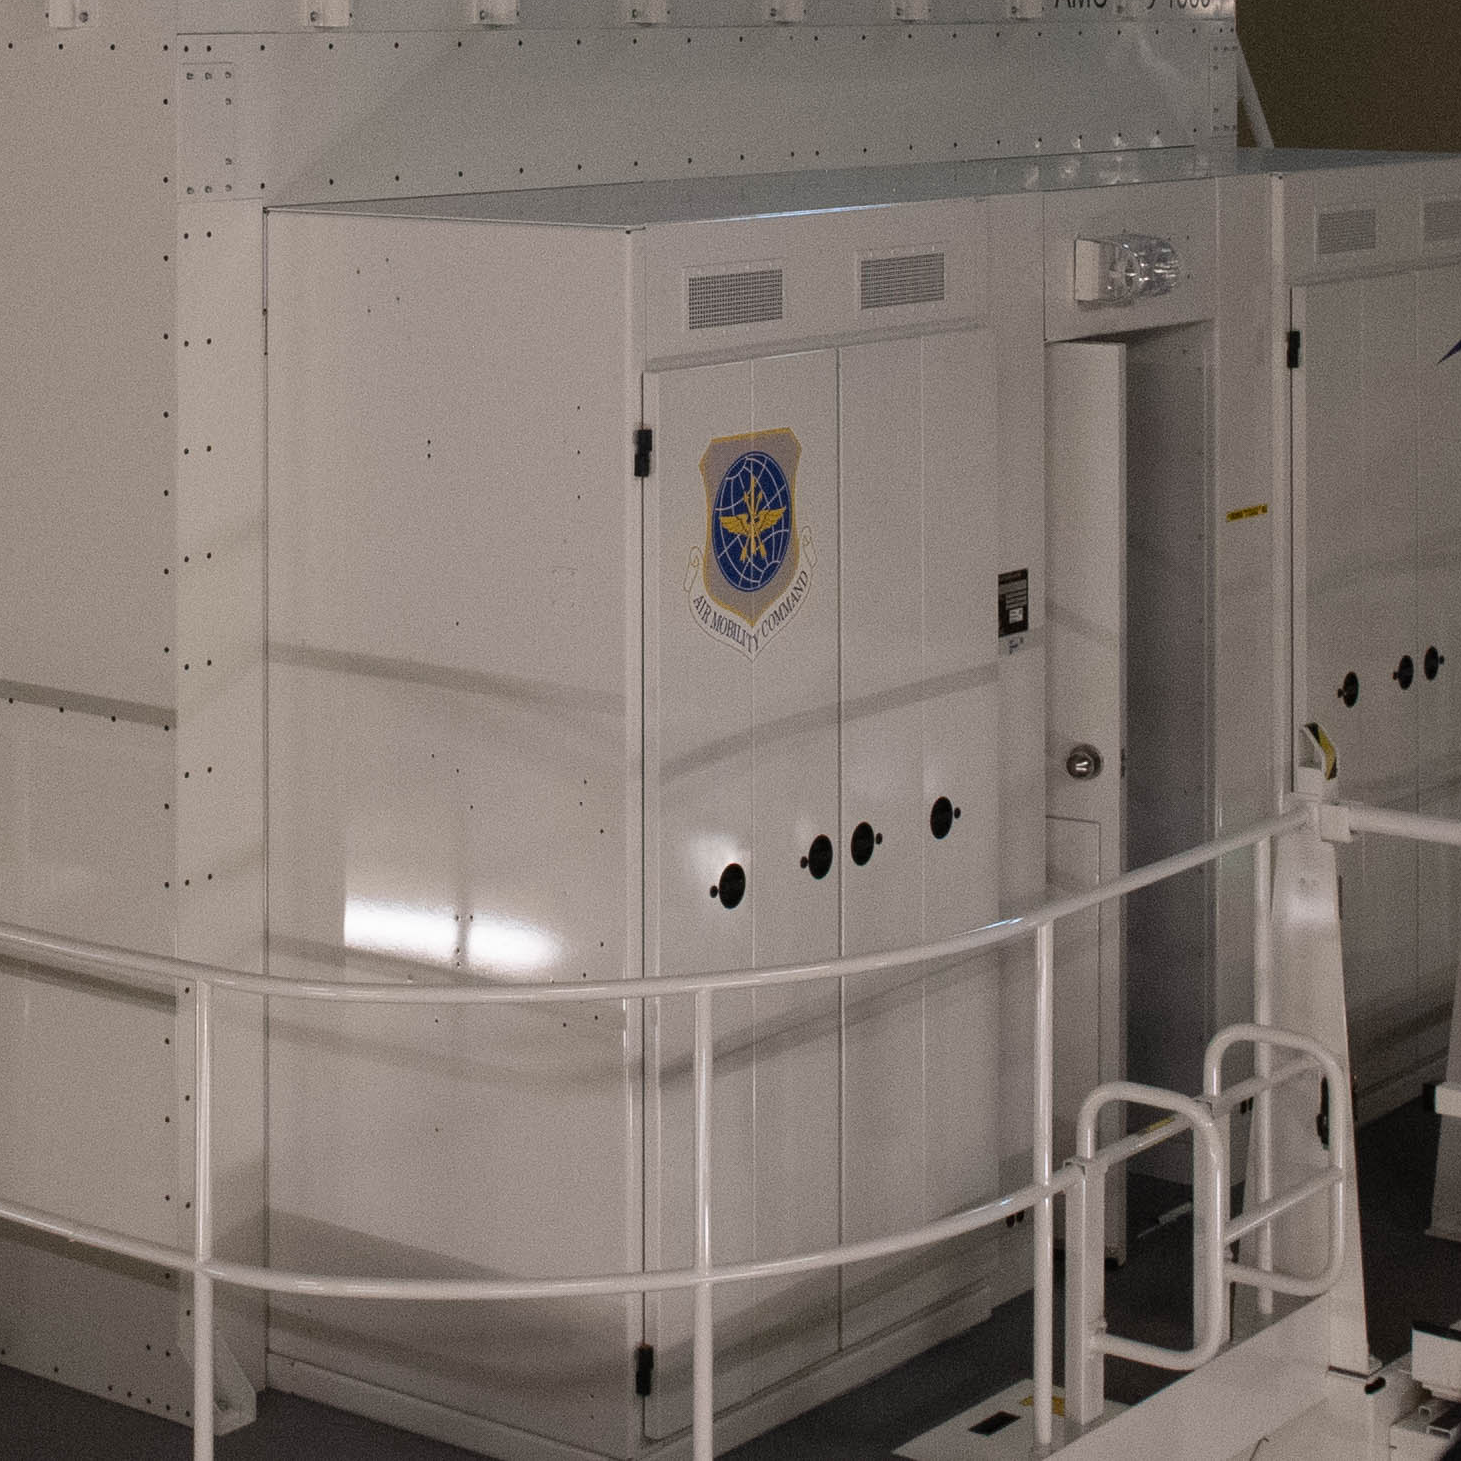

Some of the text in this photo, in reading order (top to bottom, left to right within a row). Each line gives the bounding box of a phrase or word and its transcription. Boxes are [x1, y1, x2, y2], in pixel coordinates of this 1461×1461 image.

[693, 570, 809, 654] AIR MOBILITY COMMAND
